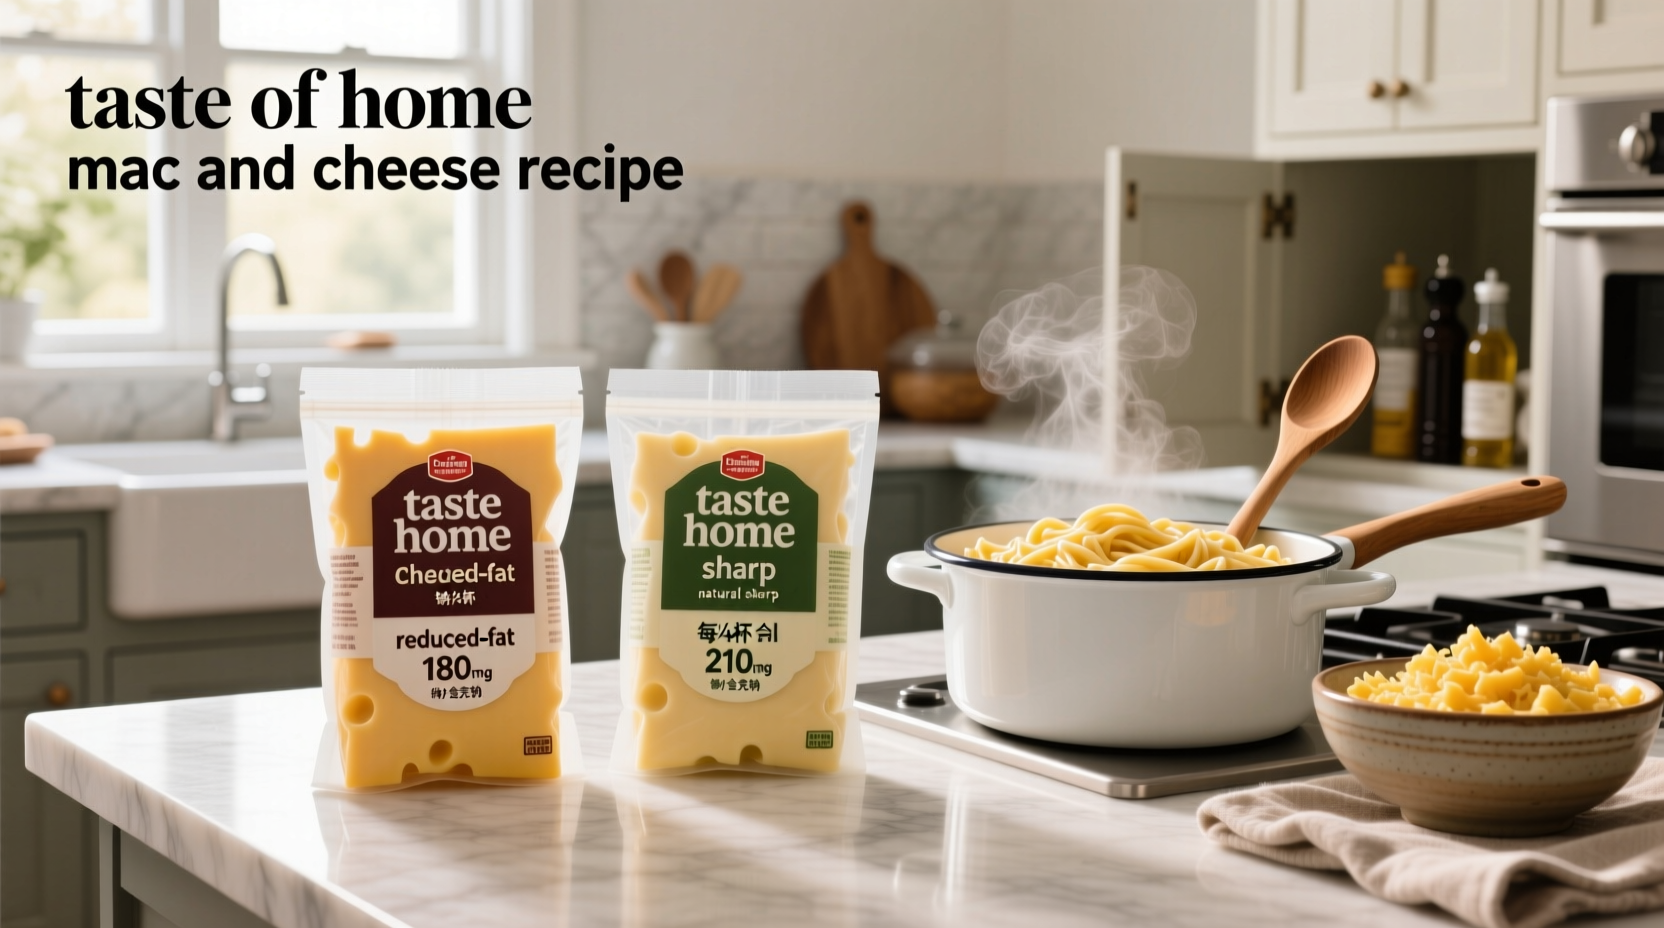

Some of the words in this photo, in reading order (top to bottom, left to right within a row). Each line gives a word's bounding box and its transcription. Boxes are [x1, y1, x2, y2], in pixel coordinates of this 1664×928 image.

[403, 489, 502, 521] taste
[696, 485, 790, 516] taste
[393, 518, 512, 554] home
[683, 512, 795, 549] home
[702, 555, 776, 587] sharp
[698, 587, 741, 600] natural
[396, 627, 515, 650] reduced-fat
